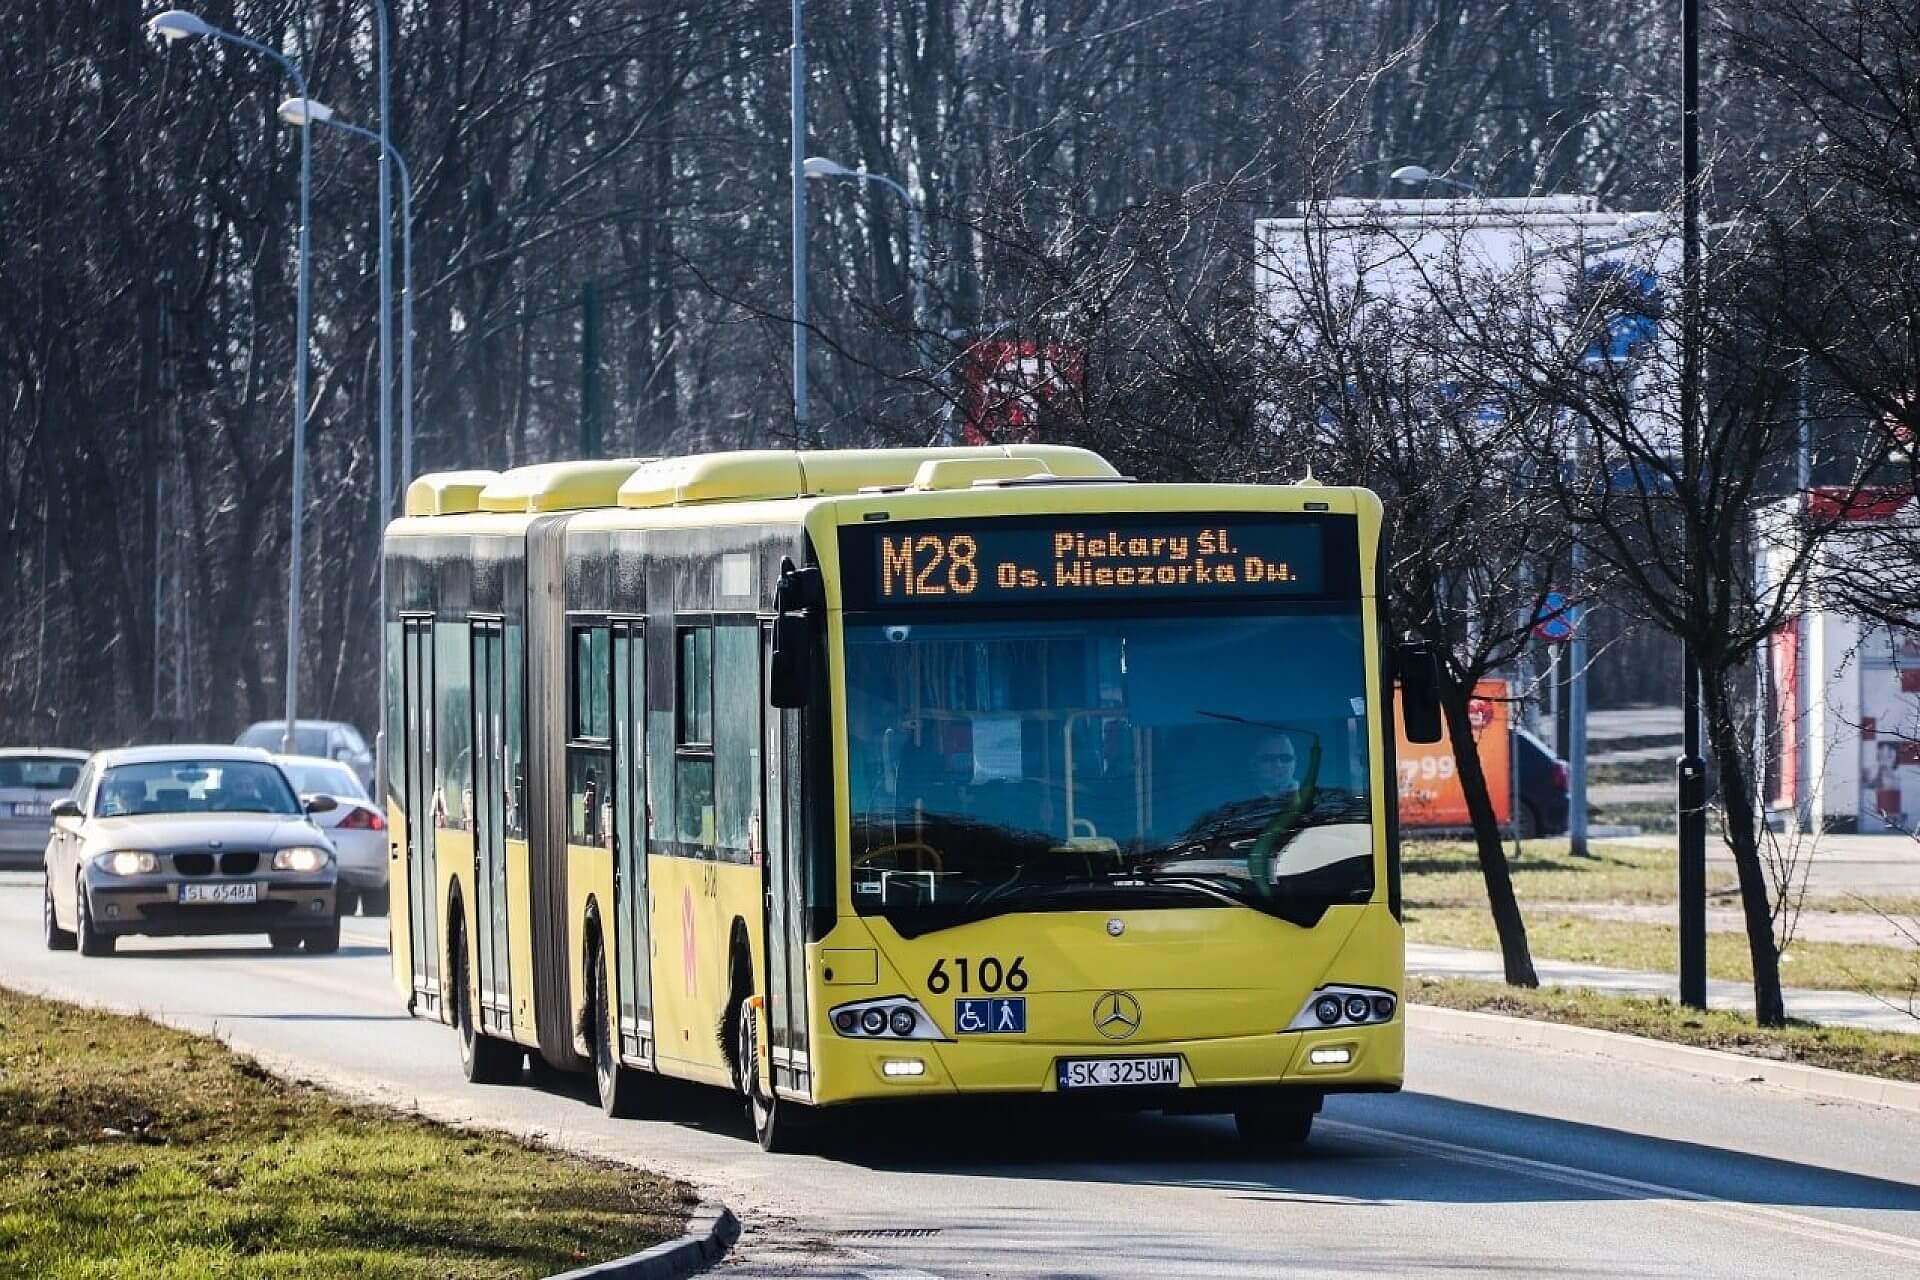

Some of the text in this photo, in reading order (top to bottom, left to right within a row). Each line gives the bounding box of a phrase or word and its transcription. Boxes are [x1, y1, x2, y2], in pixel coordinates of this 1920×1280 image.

[1054, 531, 1189, 560] Piekary
[883, 535, 978, 595] M28
[997, 556, 1297, 588] Os. Wieczorka Dw.
[927, 955, 1029, 995] 6106
[1073, 1059, 1174, 1084] SK 325UW
